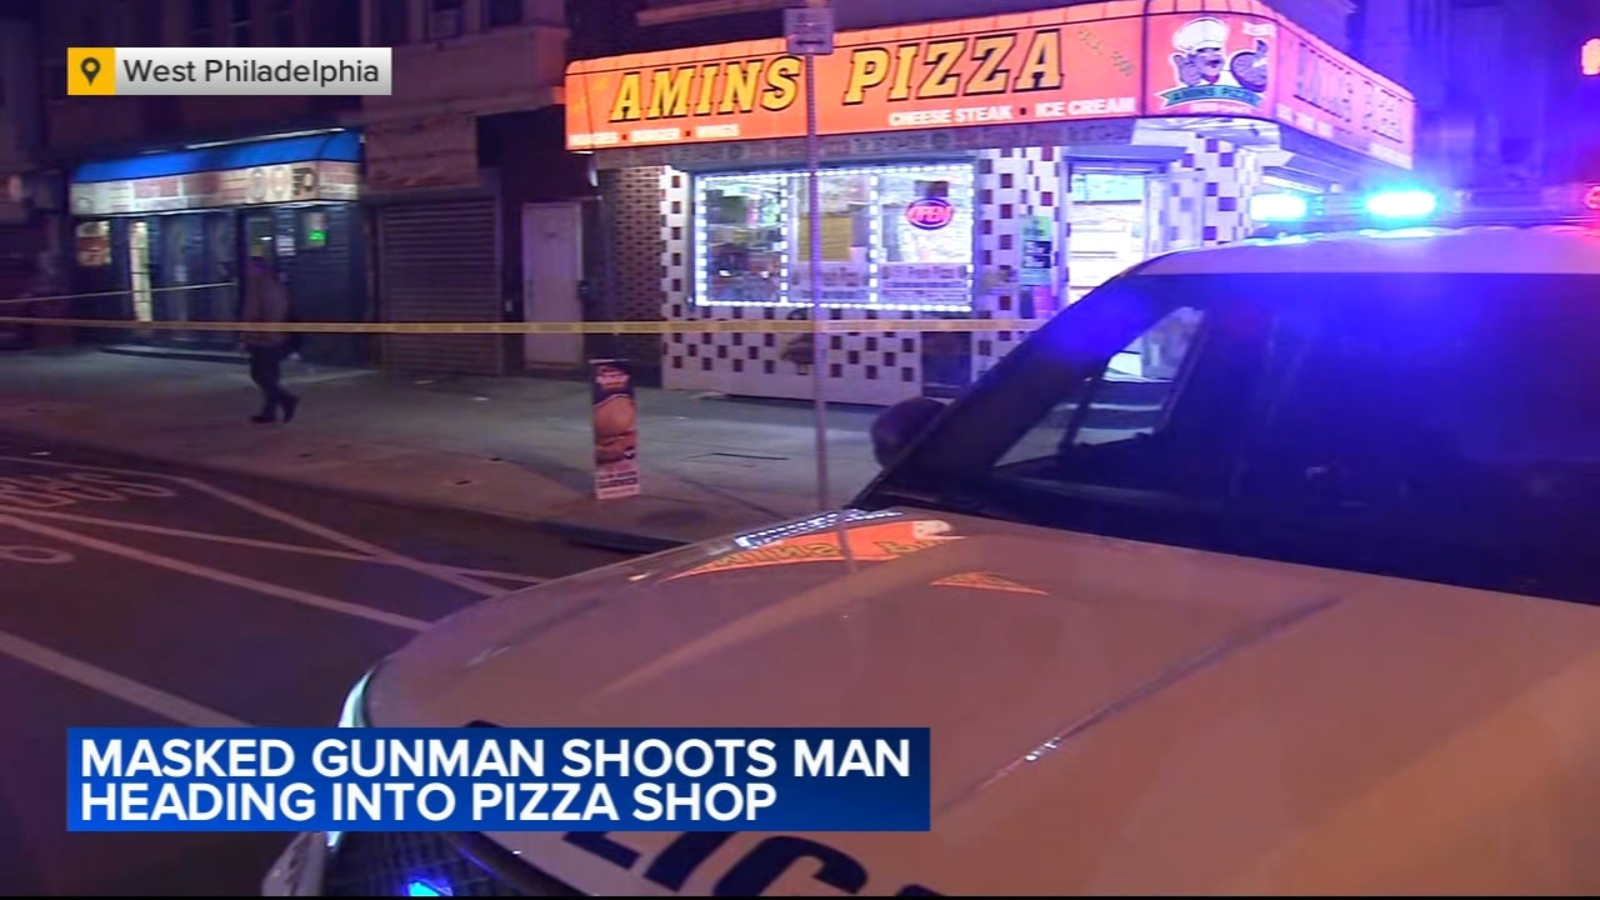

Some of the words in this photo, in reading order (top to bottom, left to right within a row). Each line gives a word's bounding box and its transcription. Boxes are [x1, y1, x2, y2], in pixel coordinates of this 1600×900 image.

[610, 56, 802, 122] AMINS
[842, 28, 1064, 106] PIZZA
[888, 109, 952, 126] CHEESE
[954, 105, 1012, 123] STEAK
[1034, 101, 1065, 118] ICE
[1067, 97, 1136, 116] CREAM
[907, 204, 953, 223] OPEN
